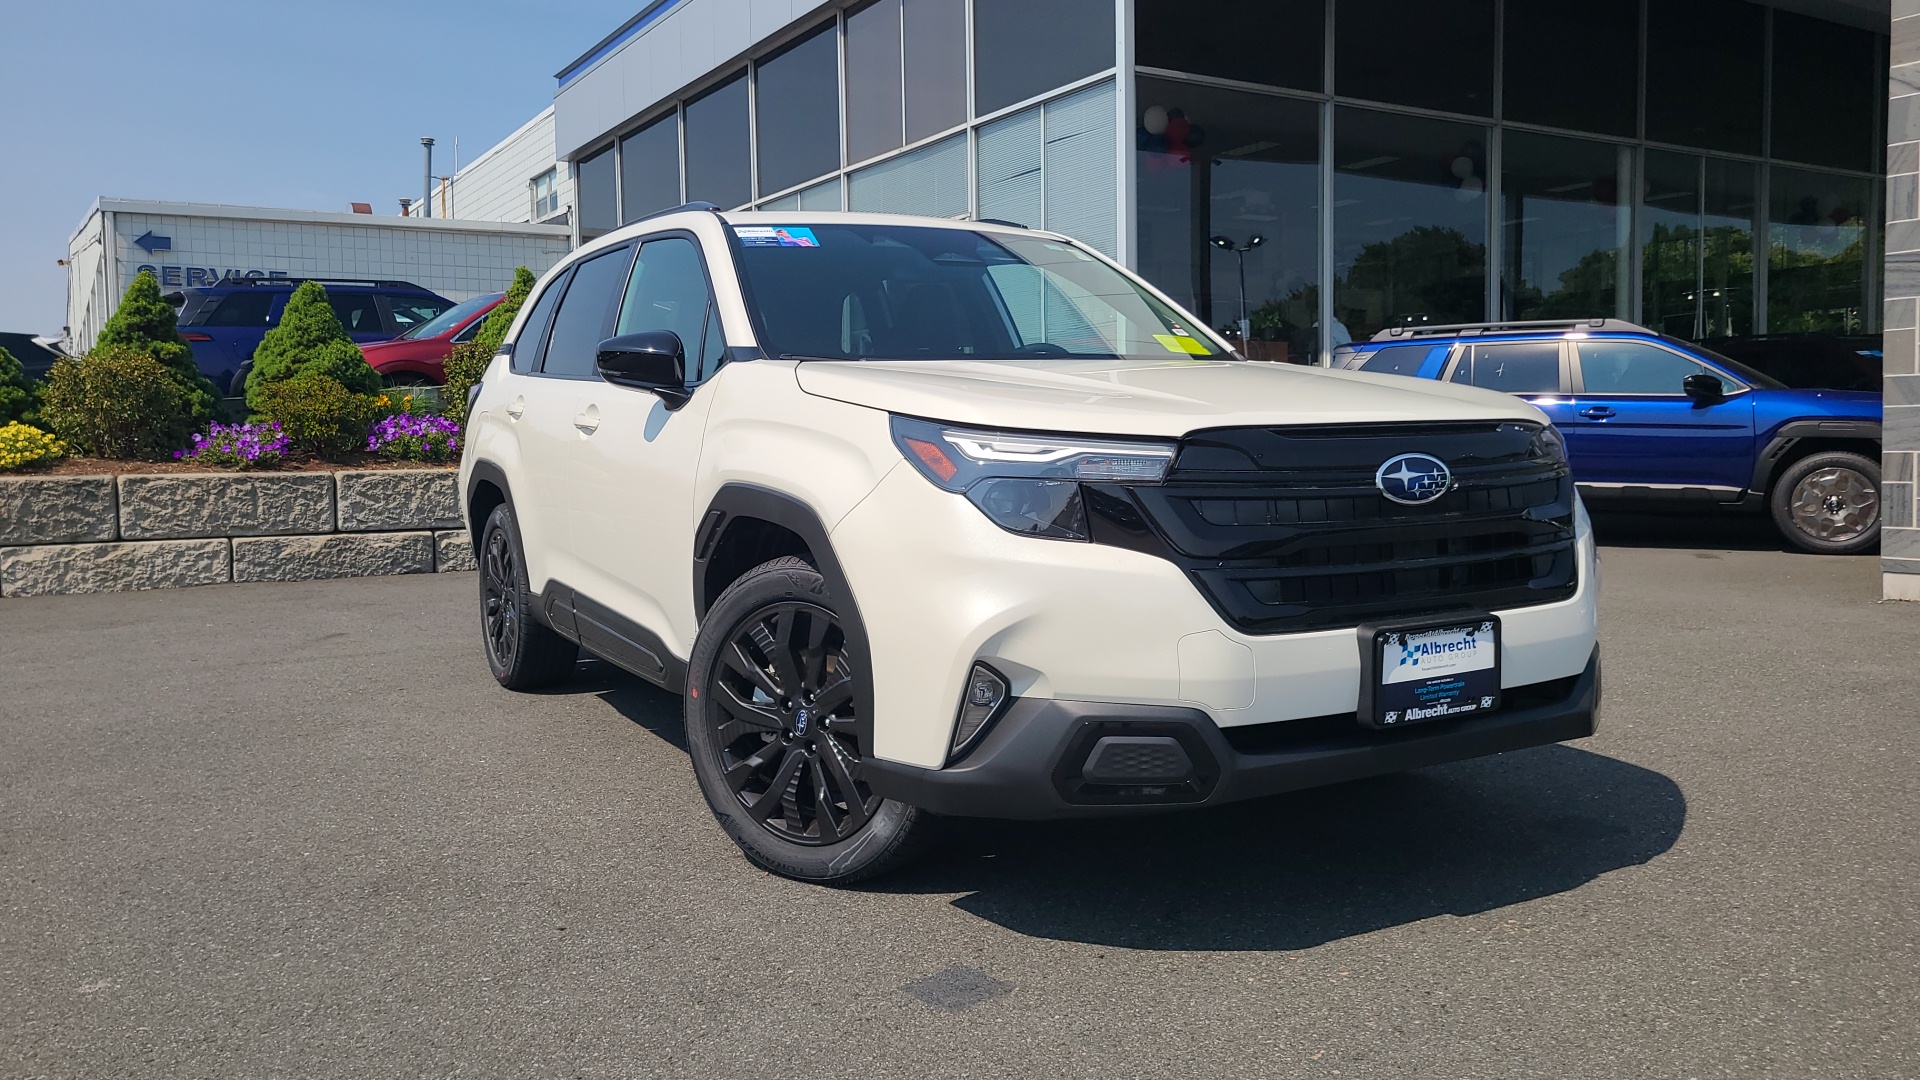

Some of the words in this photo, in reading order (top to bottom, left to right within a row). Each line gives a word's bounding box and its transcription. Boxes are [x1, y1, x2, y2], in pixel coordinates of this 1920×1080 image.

[1421, 638, 1477, 656] Albrecht
[1421, 654, 1444, 664] AUTO
[1449, 650, 1477, 661] GROUP
[1414, 685, 1439, 694] Long-Term
[1440, 681, 1465, 689] Powertrain
[1420, 693, 1437, 701] Limited
[1438, 690, 1460, 698] Warranty
[1405, 703, 1449, 721] Albrecht
[1448, 706, 1461, 714] AUTO
[1461, 704, 1477, 712] GROUP
